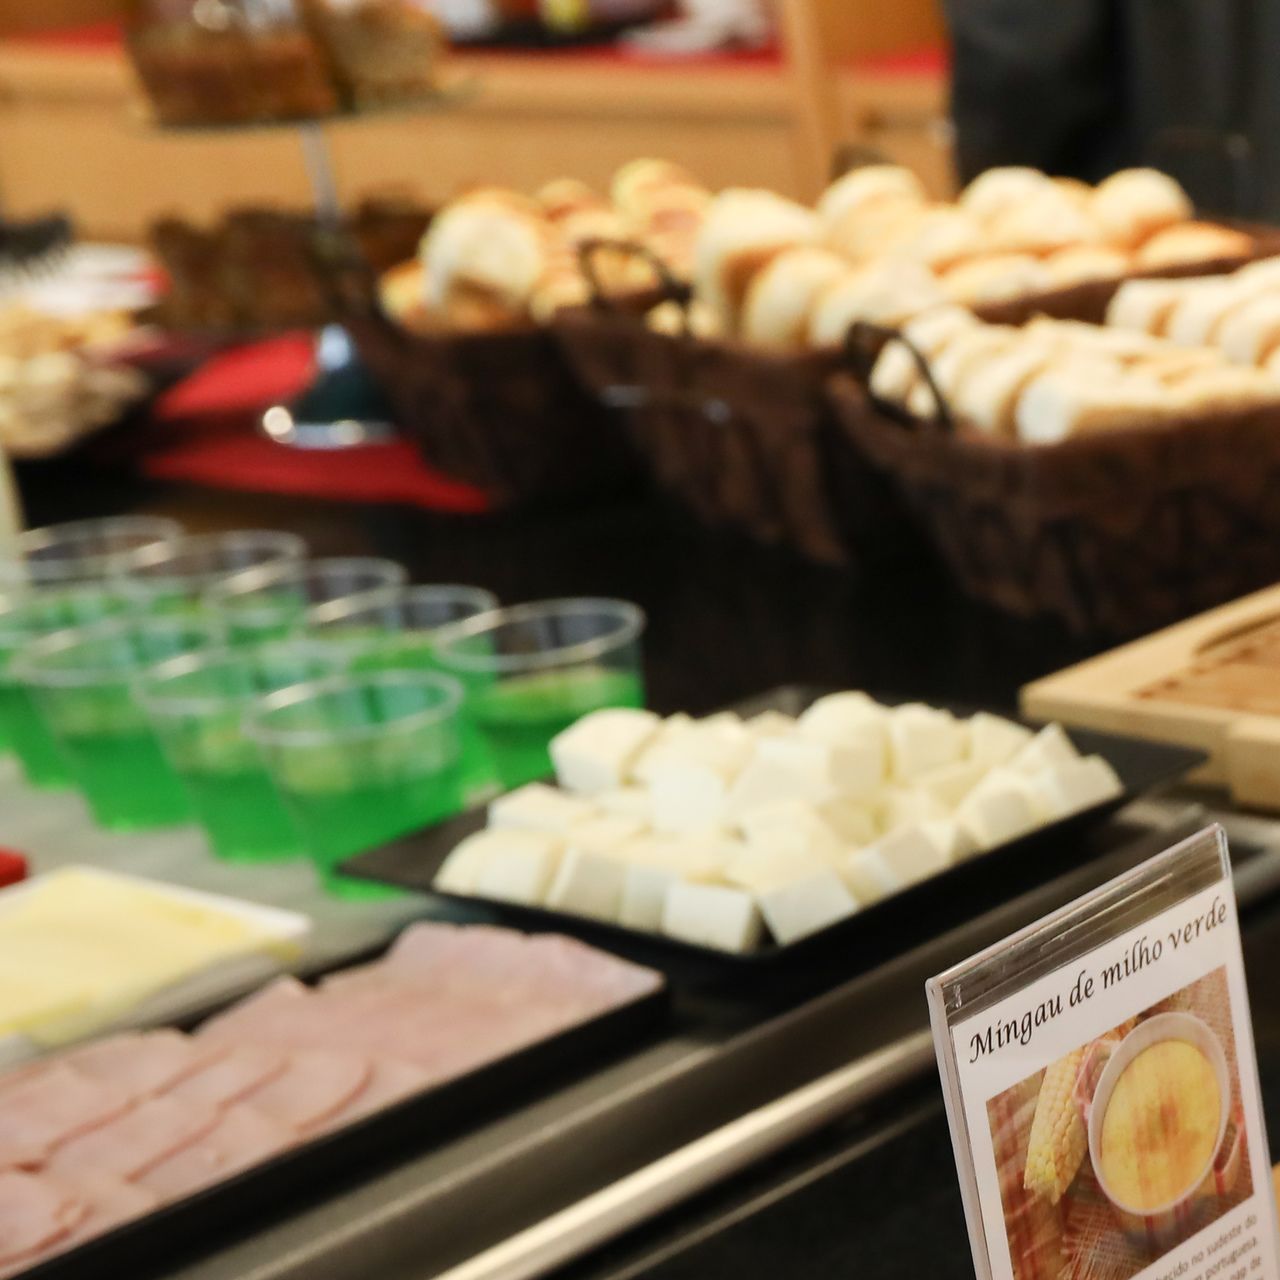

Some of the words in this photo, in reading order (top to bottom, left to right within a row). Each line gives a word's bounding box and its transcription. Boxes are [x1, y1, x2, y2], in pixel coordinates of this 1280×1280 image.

[969, 995, 1063, 1064] Mingau
[1069, 970, 1094, 1008] de
[1100, 936, 1162, 989] milho
[1167, 895, 1227, 950] verde
